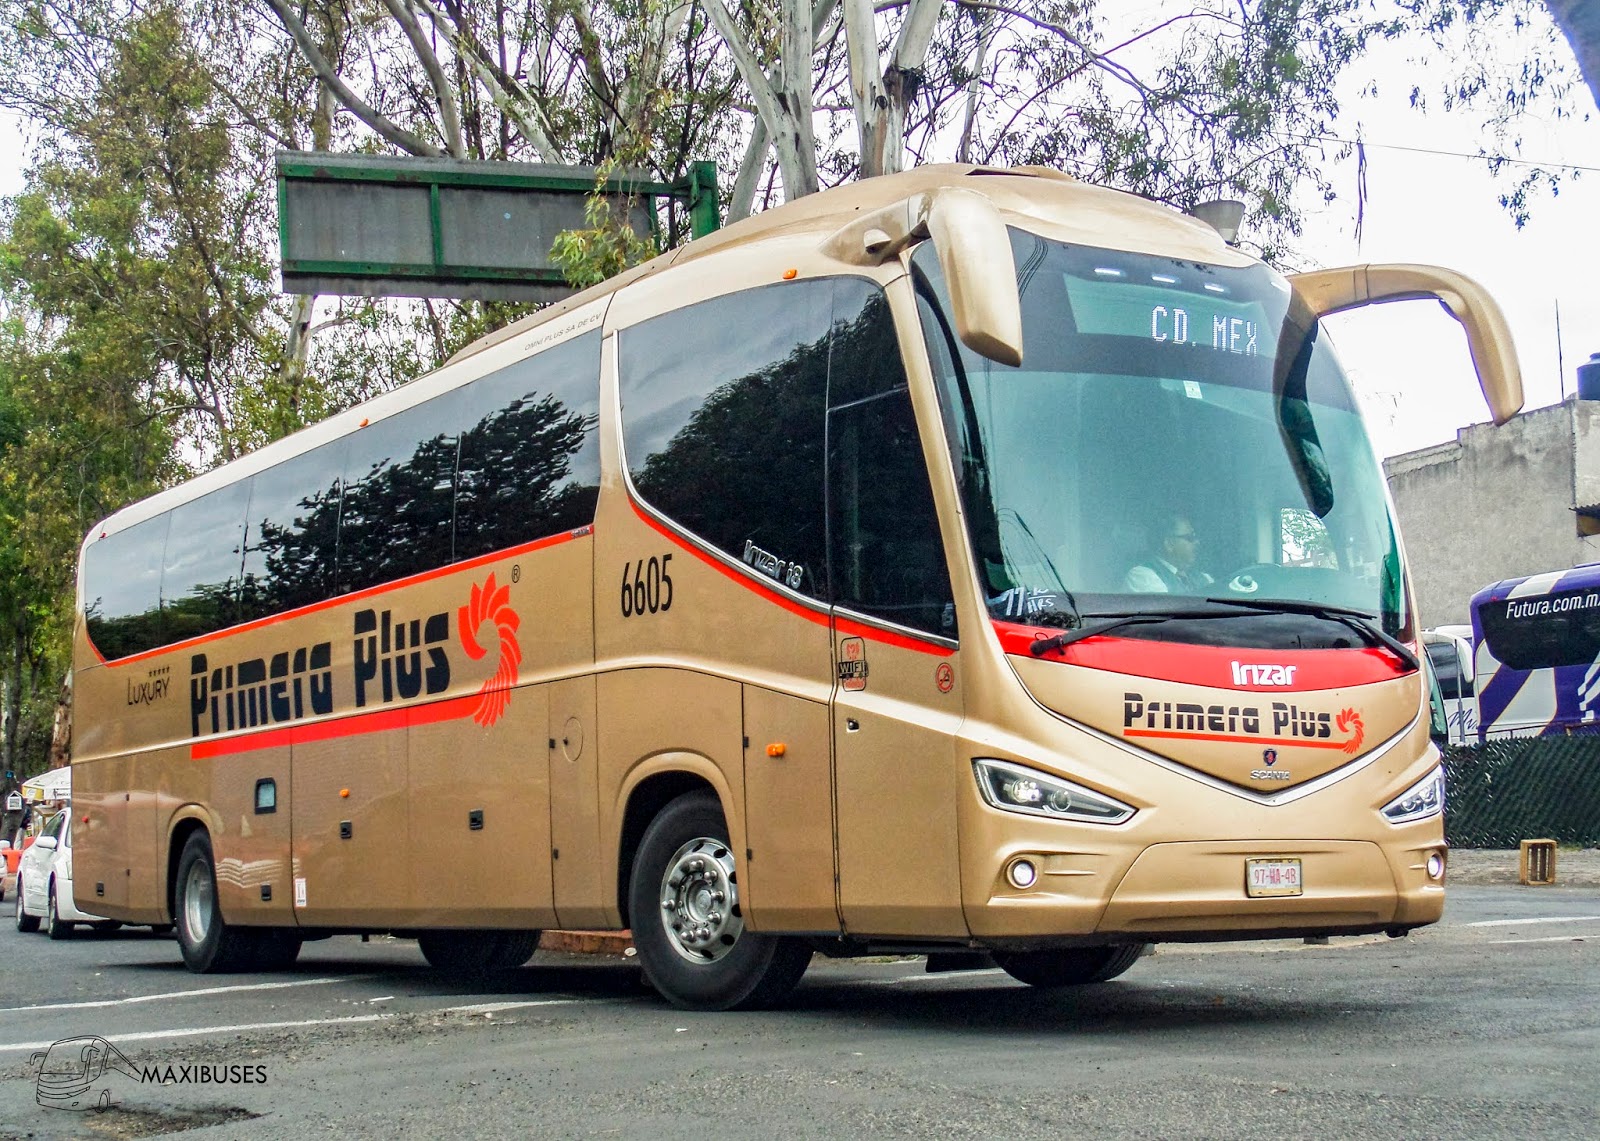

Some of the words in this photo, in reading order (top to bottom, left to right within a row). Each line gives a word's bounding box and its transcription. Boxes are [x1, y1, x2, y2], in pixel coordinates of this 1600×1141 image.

[524, 336, 543, 351] OMNI
[544, 329, 564, 343] PLUS
[565, 324, 576, 334] SA
[577, 317, 589, 329] DE
[590, 312, 602, 323] CV
[1152, 305, 1196, 346] CD.
[1213, 314, 1257, 357] MEX
[621, 553, 673, 618] 6605
[190, 641, 333, 737] Primera
[353, 608, 450, 707] Plus
[1231, 660, 1297, 686] Irizar
[1124, 692, 1260, 734] Primera
[1272, 702, 1331, 738] Plus
[1250, 769, 1291, 781] SCANIA
